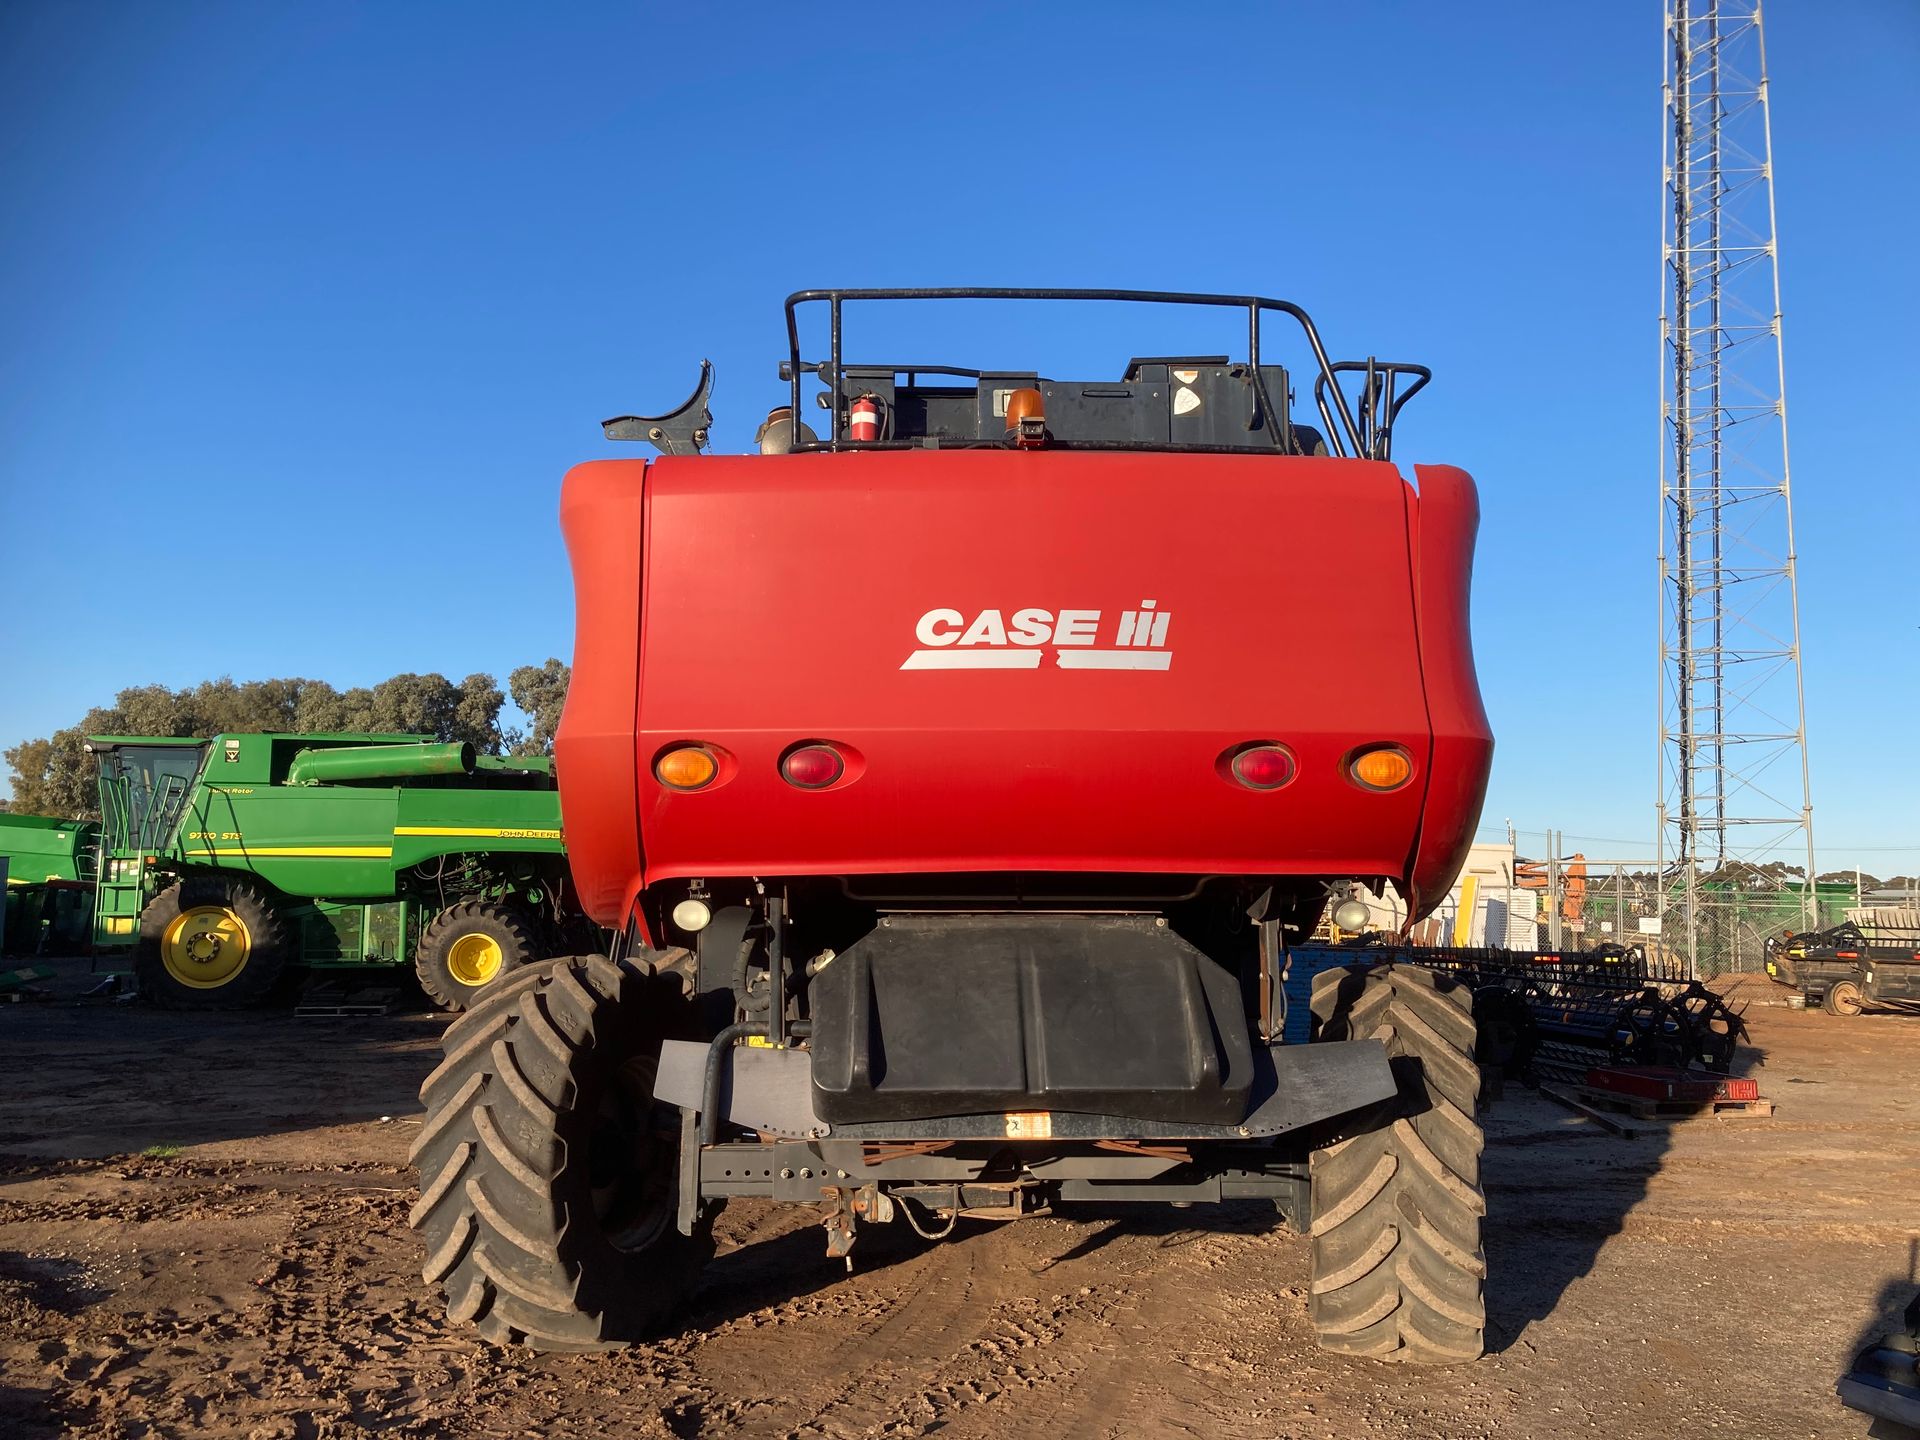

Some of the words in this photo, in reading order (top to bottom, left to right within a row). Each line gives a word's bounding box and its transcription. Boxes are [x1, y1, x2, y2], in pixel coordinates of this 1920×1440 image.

[915, 608, 1102, 647] CASE
[221, 832, 243, 840] STS
[526, 830, 560, 838] DEERE
